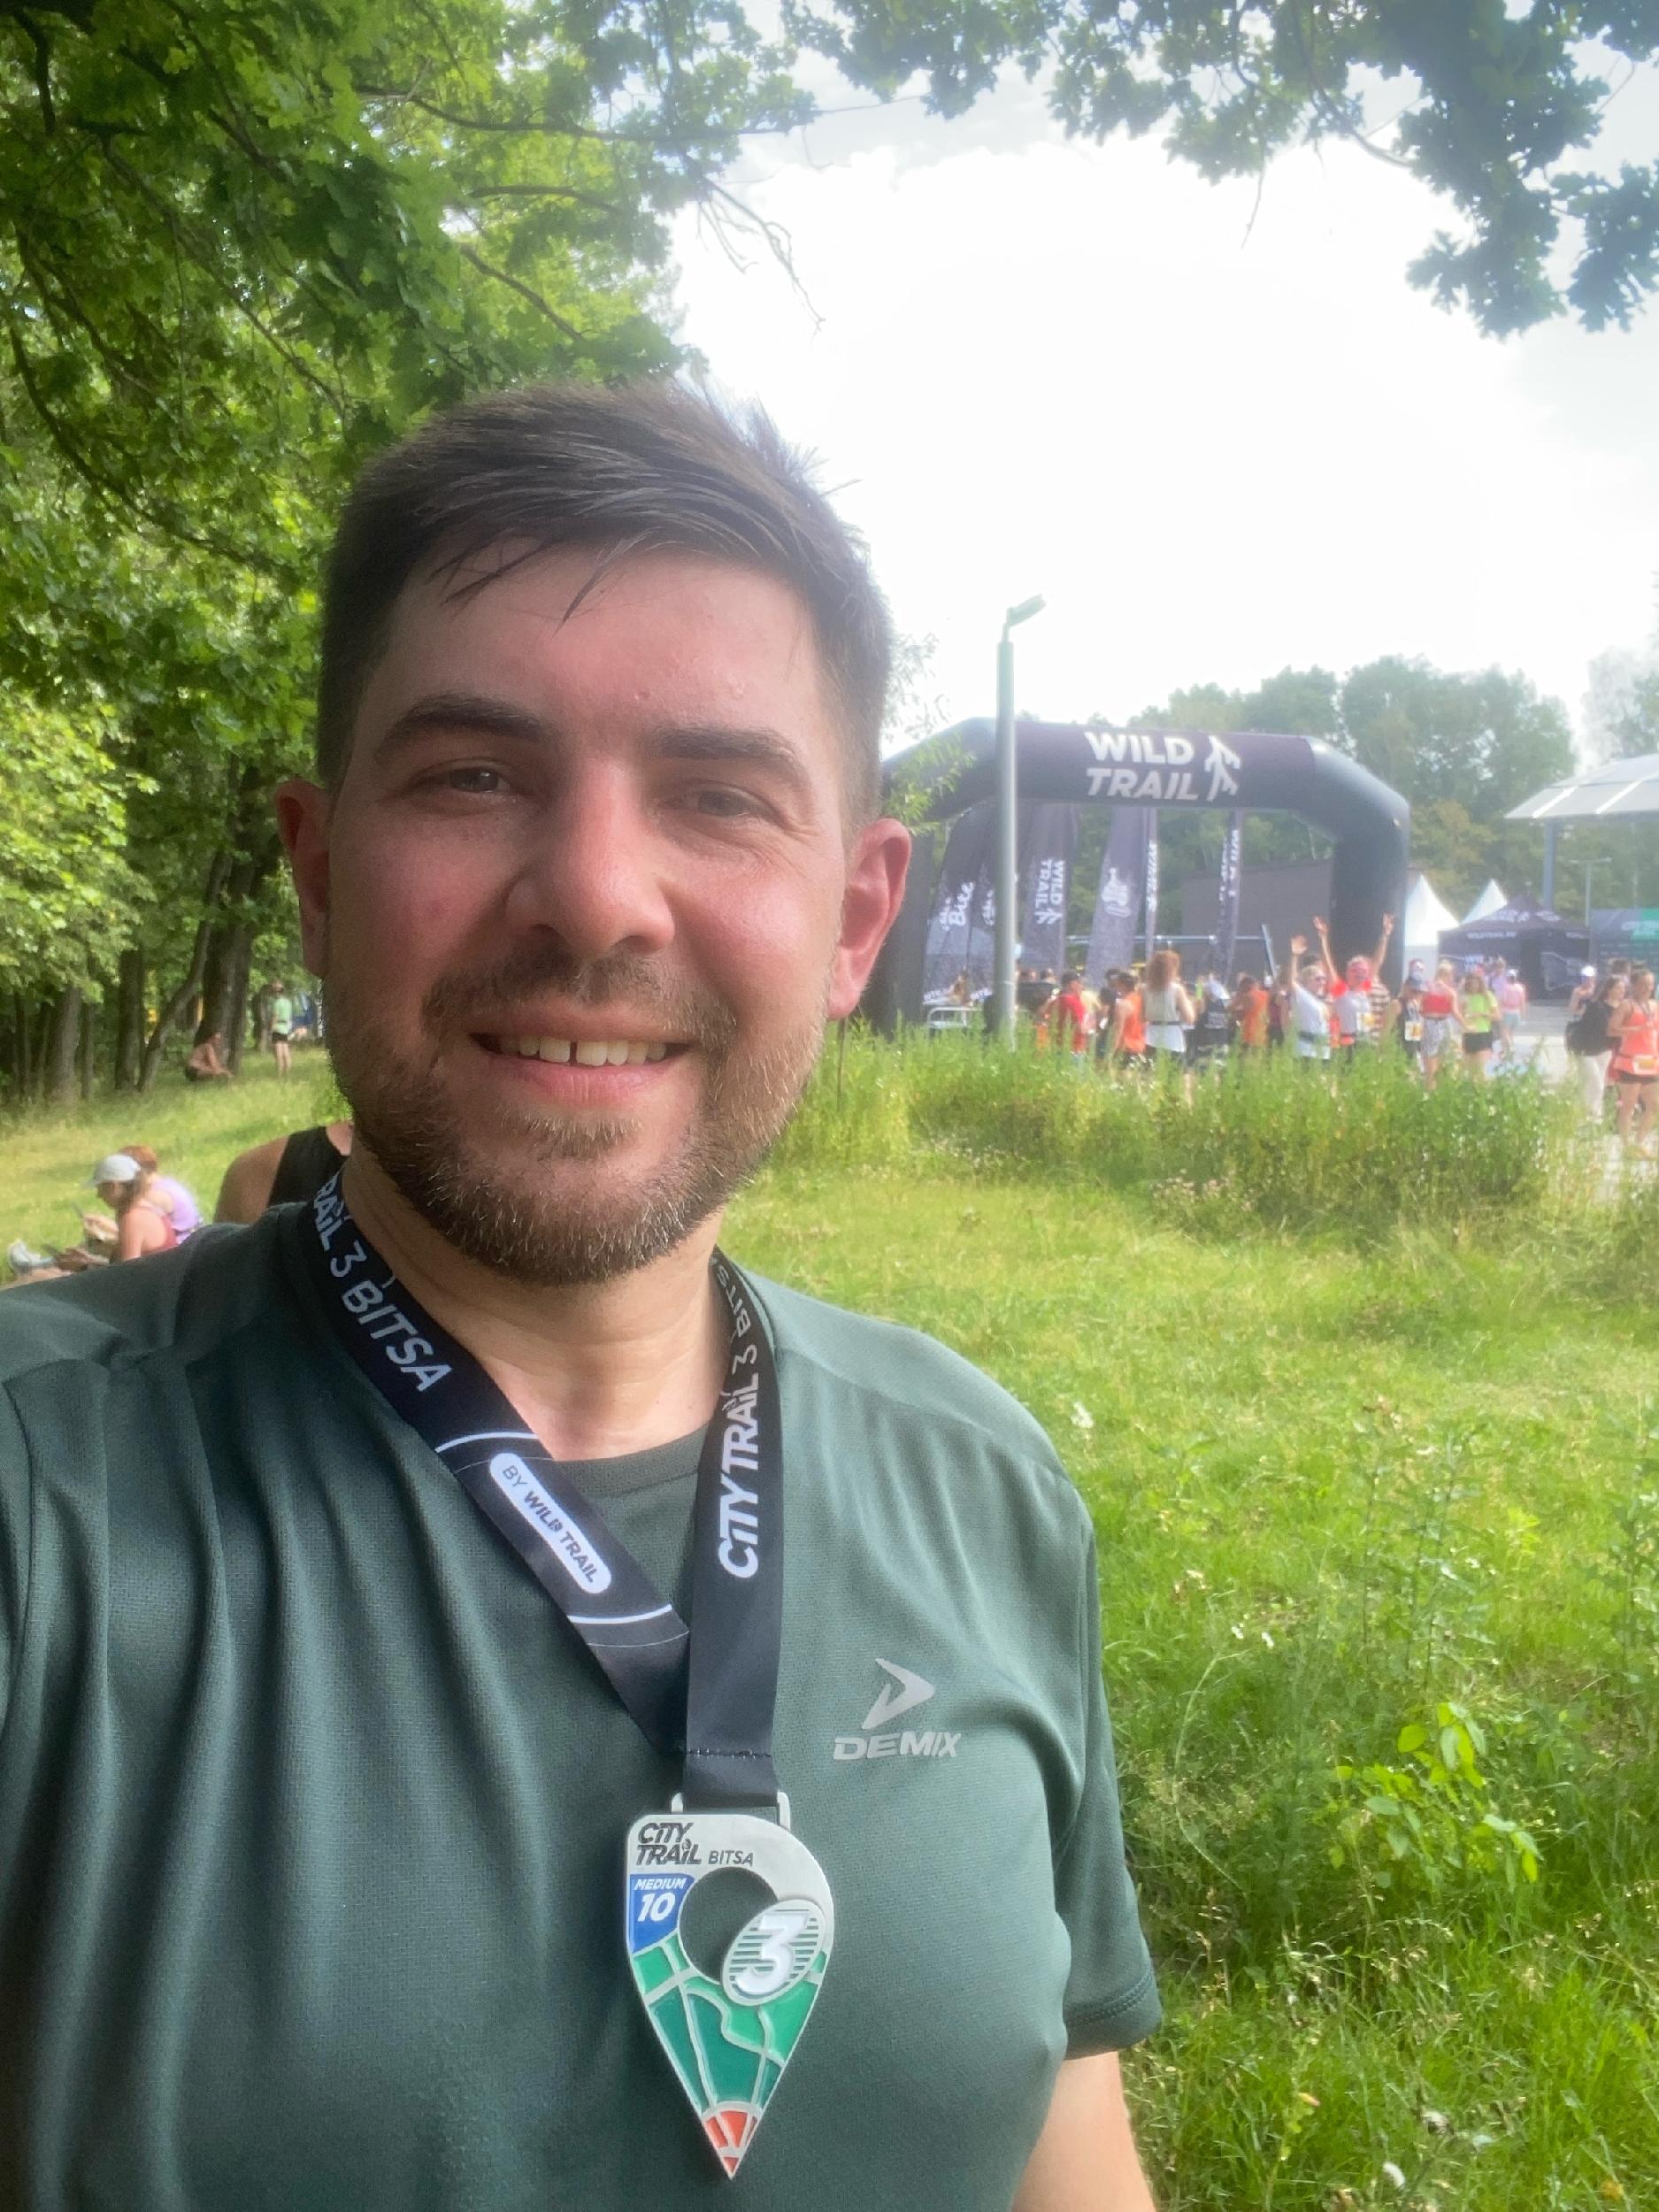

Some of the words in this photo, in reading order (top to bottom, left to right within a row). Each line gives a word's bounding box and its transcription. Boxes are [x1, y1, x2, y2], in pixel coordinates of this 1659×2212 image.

[1084, 732, 1195, 765] WILD
[1086, 767, 1198, 801] TRAIL
[1035, 859, 1052, 909] TRAIL
[1049, 859, 1065, 906] WILD
[330, 1240, 367, 1278] 3
[342, 1279, 452, 1393] BITSA
[732, 1344, 757, 1375] 3
[503, 1465, 528, 1487] BY
[524, 1491, 564, 1532] WILD
[560, 1531, 598, 1583] TRAIL
[833, 1731, 962, 1760] DEMIX
[638, 1823, 694, 1844] CITY
[635, 1841, 702, 1865] TRAIL
[708, 1849, 754, 1866] BITSA
[634, 1878, 687, 1890] MEDIUM
[637, 1892, 676, 1922] 10
[735, 1913, 810, 1996] 3
